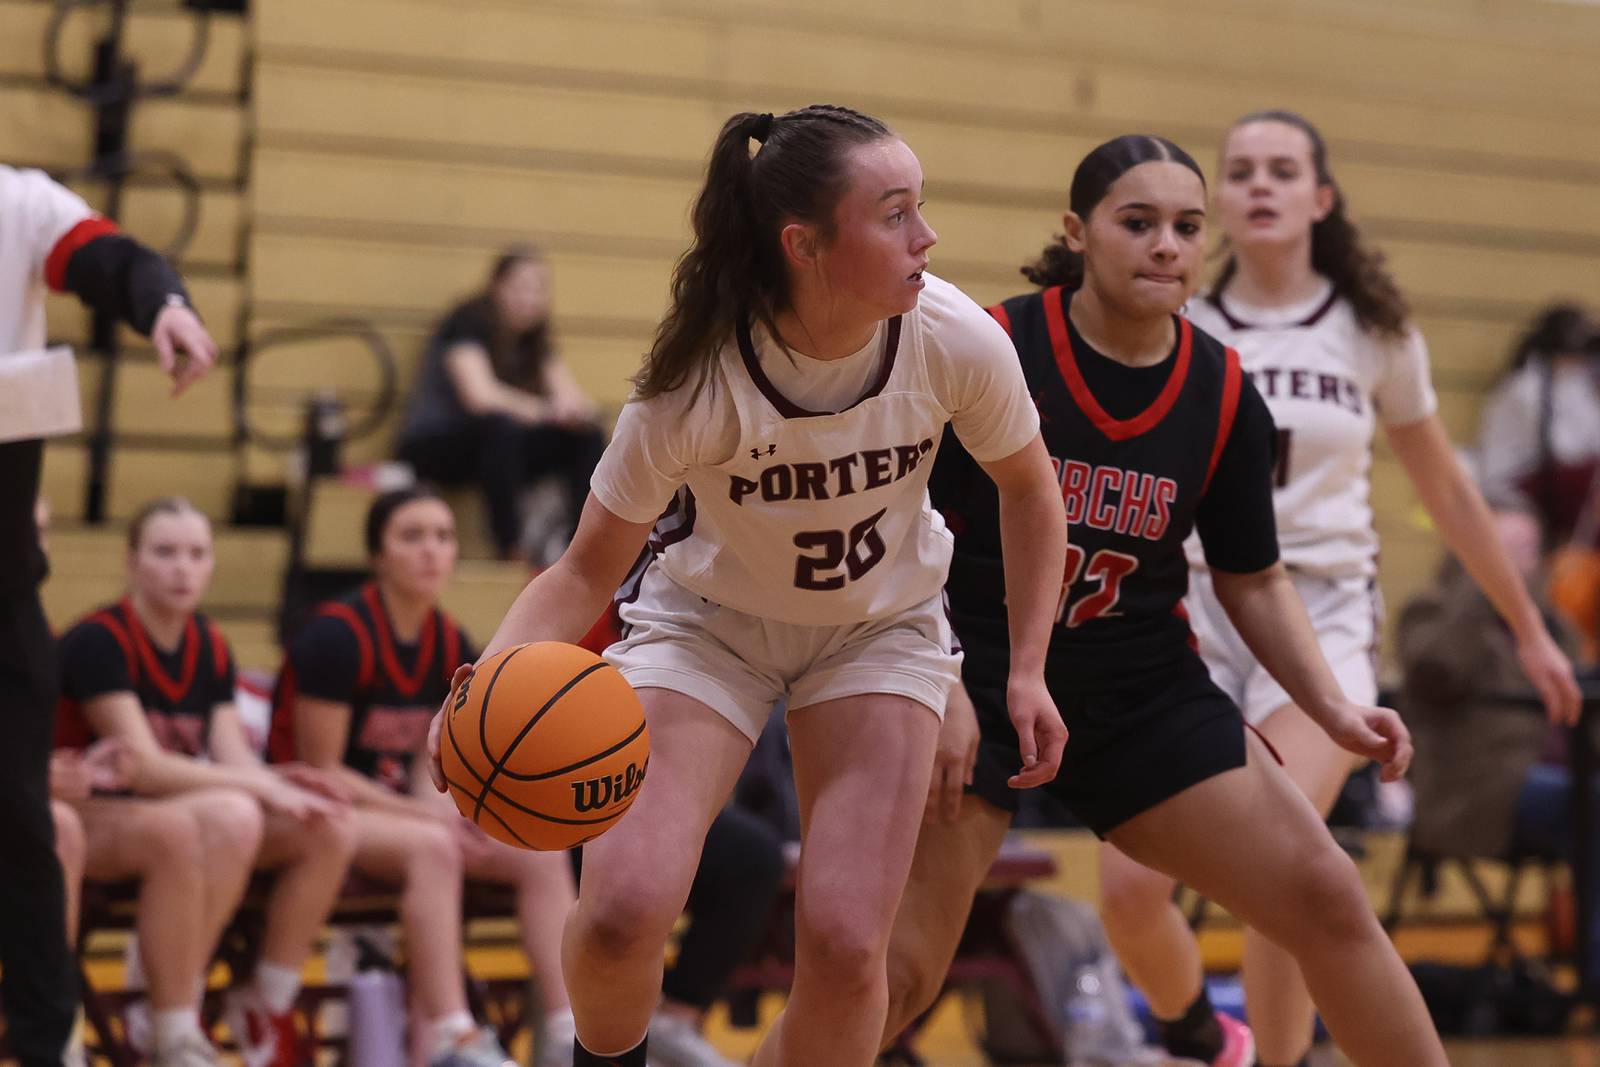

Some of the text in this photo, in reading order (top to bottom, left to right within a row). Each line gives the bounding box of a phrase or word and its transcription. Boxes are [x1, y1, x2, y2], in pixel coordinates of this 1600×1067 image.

[1247, 367, 1362, 415] TERS
[1050, 456, 1178, 541] BCHS
[793, 506, 888, 591] 20
[571, 756, 649, 813] Wils
